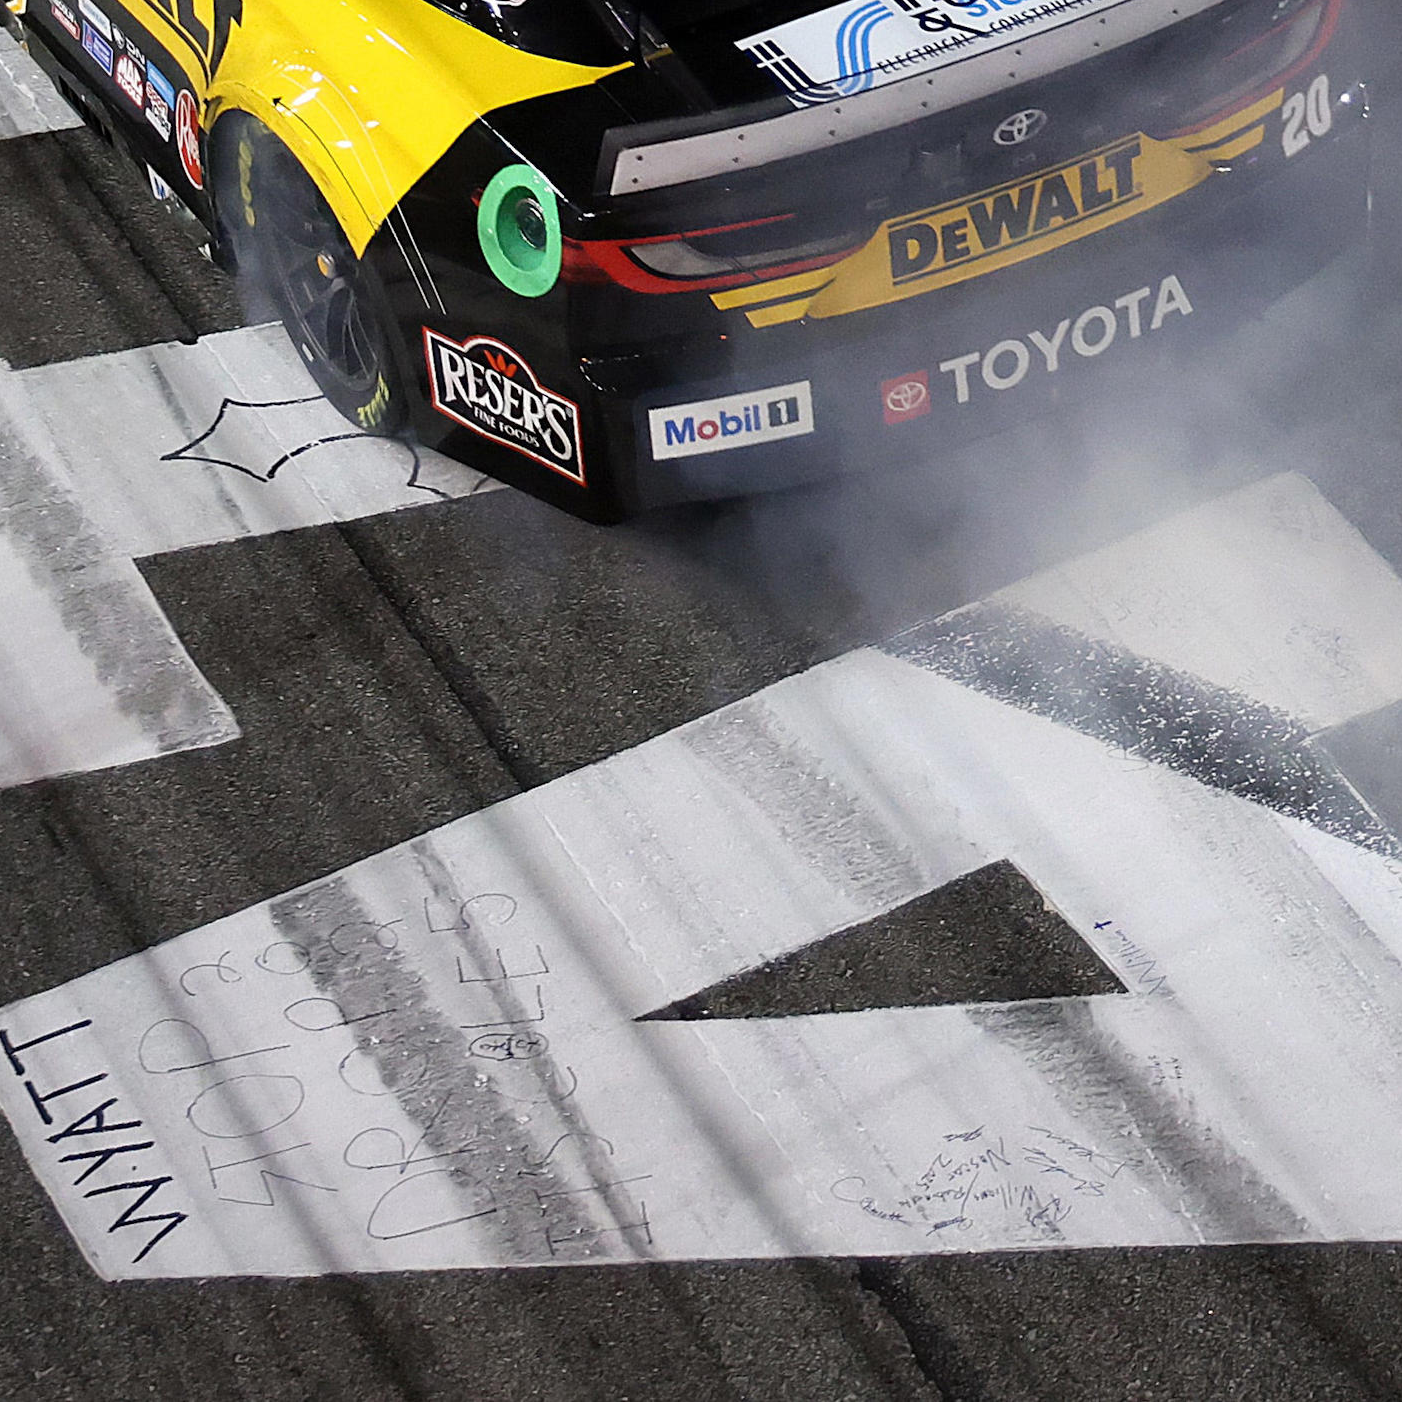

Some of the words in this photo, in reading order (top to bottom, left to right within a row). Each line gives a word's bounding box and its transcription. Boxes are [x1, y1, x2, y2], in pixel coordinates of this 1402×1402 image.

[1280, 74, 1333, 160] 20
[938, 273, 1194, 406] TOYOTA
[437, 343, 573, 462] RESER'S
[473, 406, 497, 431] FINE
[498, 421, 541, 449] FOODS
[663, 406, 764, 449] Mobil
[771, 398, 794, 425] 1
